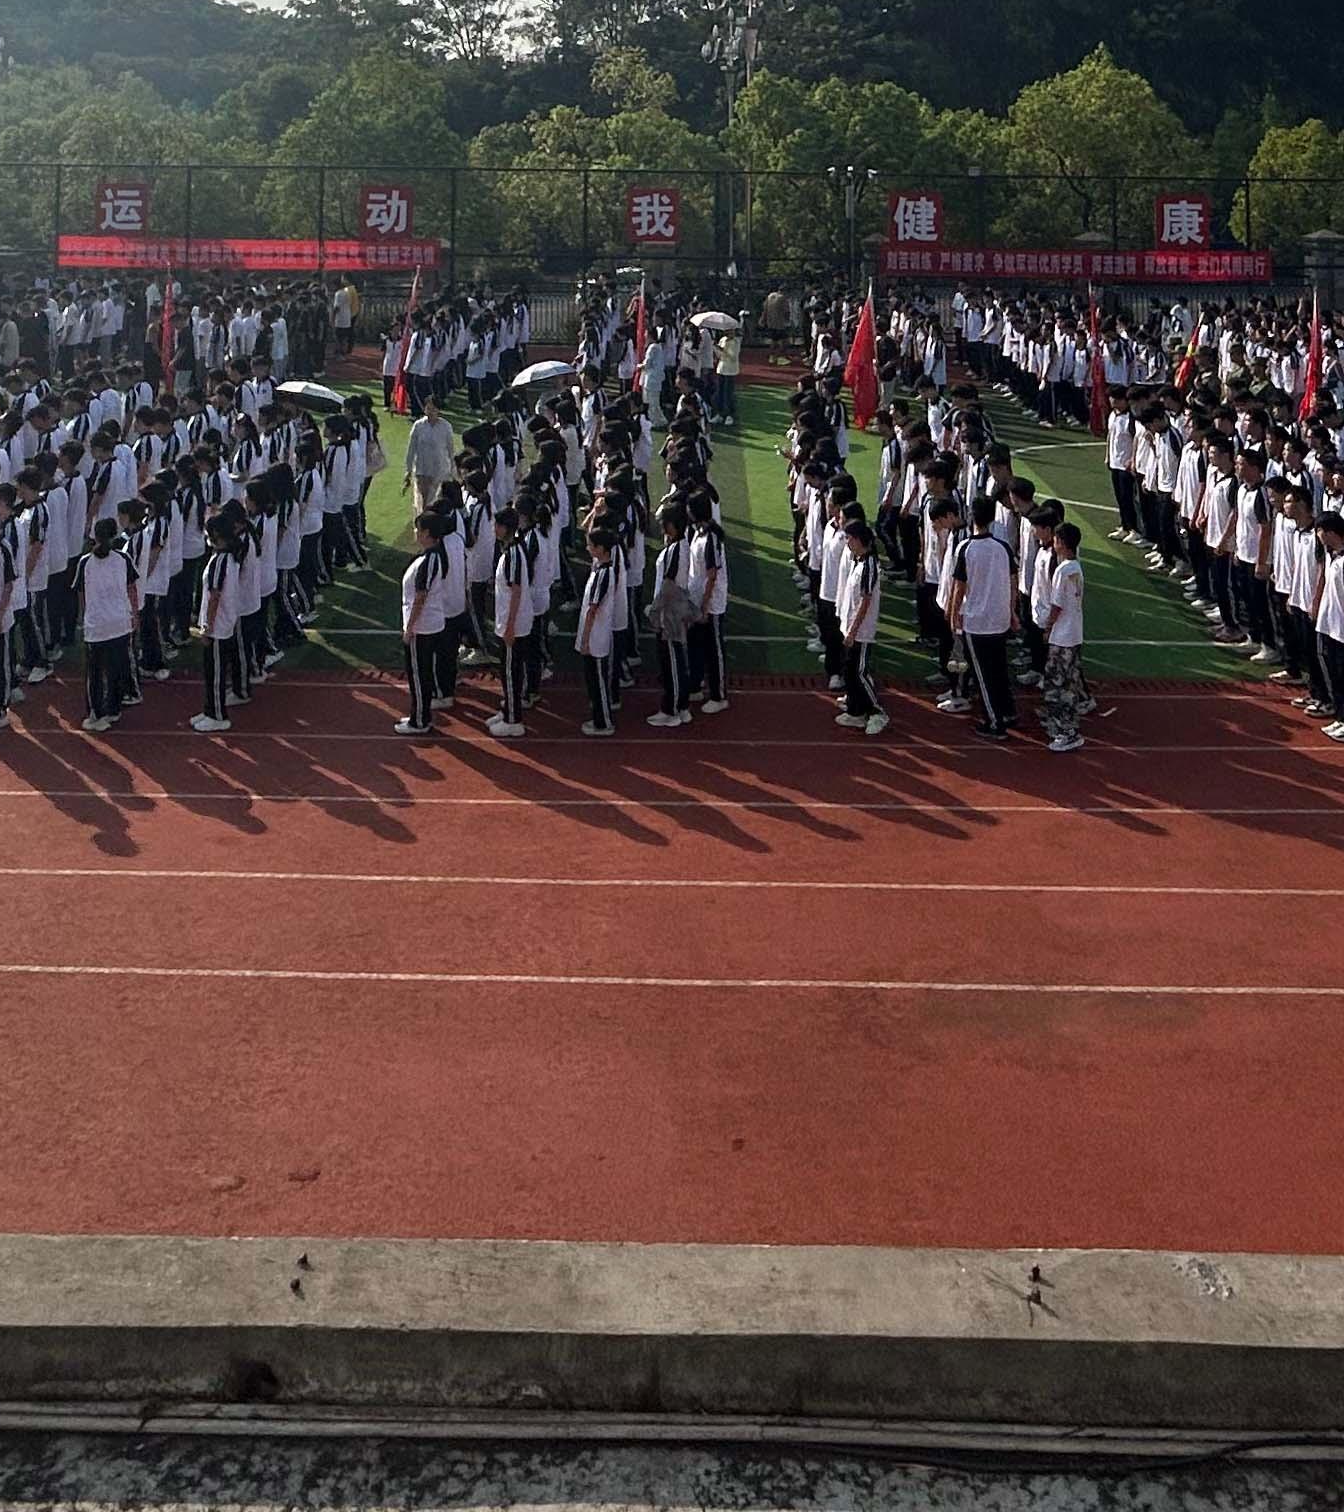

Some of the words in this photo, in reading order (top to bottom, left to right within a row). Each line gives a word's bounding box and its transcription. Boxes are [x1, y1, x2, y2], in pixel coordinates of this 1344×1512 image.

[99, 188, 143, 231] 运
[366, 190, 407, 234] 动
[631, 193, 675, 237] 我
[894, 196, 938, 241] 健
[1161, 199, 1204, 245] 康
